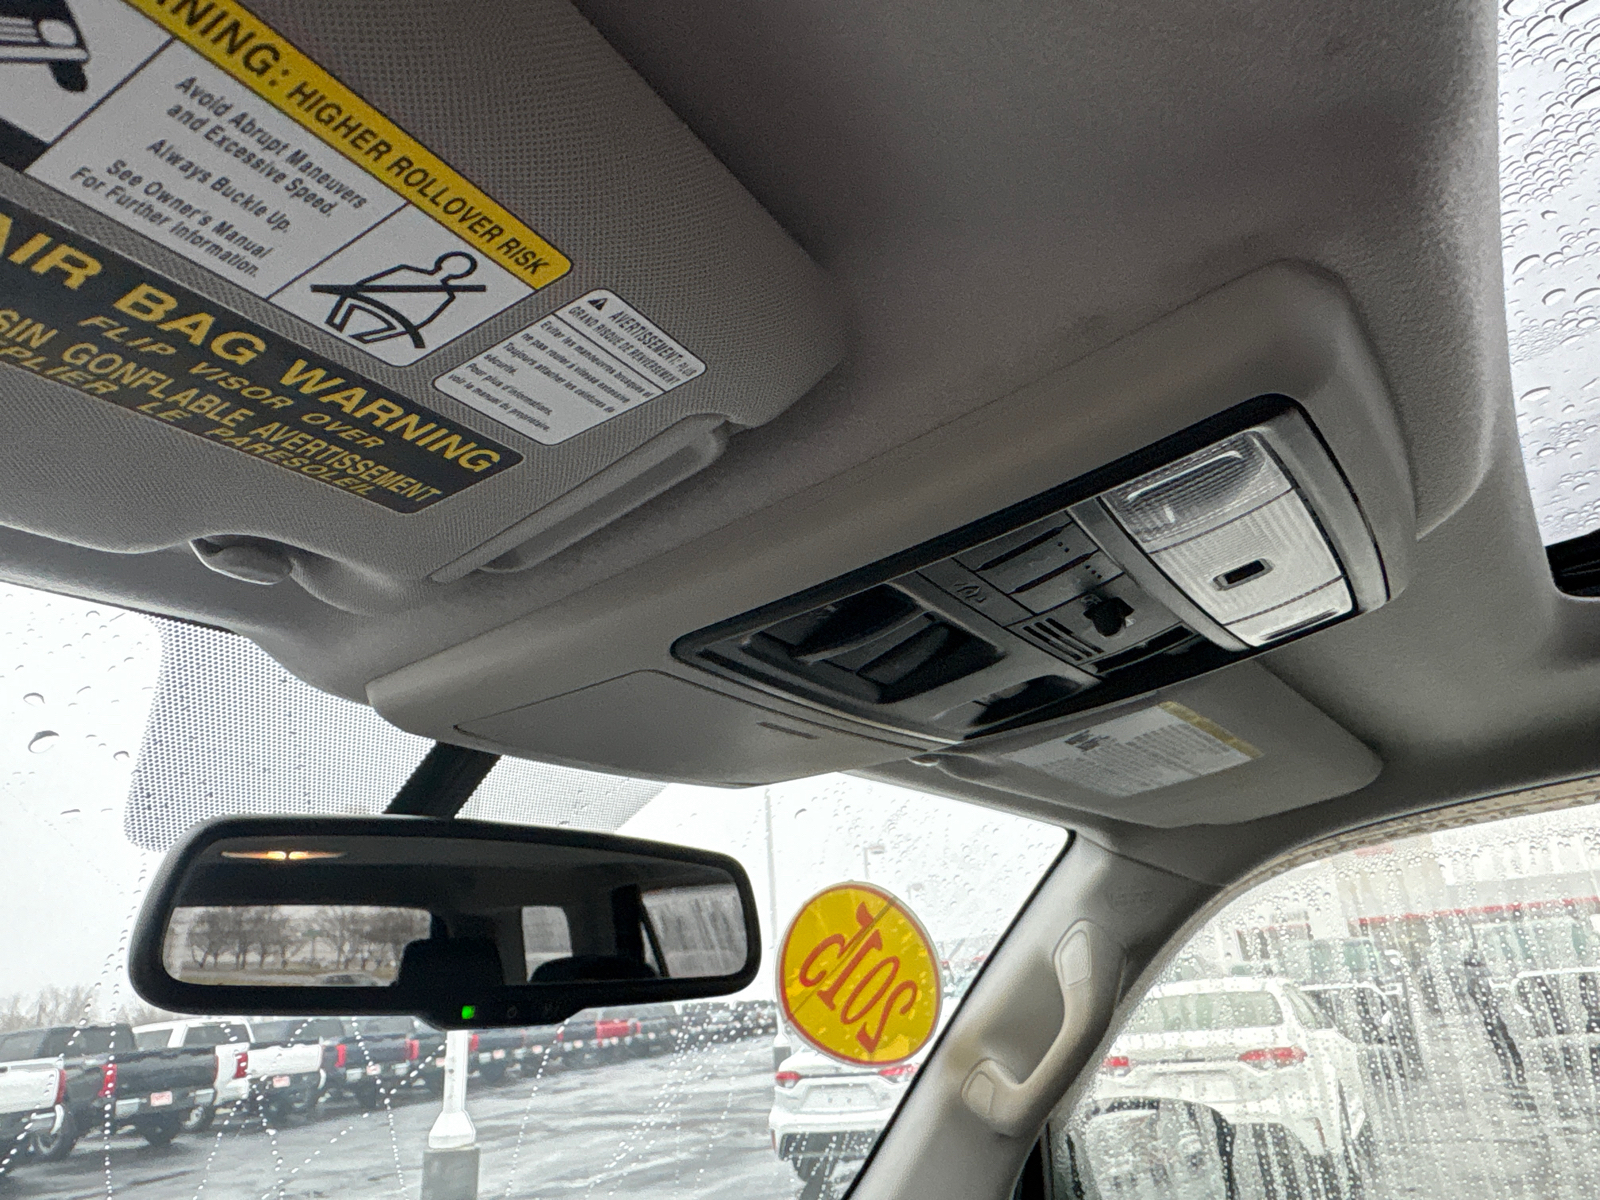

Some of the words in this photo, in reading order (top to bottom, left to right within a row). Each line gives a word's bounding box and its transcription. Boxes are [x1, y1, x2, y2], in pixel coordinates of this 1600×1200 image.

[146, 139, 212, 184] Always
[210, 176, 268, 217] Buckle
[266, 210, 291, 233] Up.
[157, 0, 290, 87] NING:
[285, 80, 393, 163] HIGHER
[385, 154, 504, 244] ROLLOVER
[497, 236, 550, 276] RISK
[166, 104, 210, 132] and
[203, 124, 287, 184] Excessive
[284, 177, 338, 217] Speed.
[175, 76, 234, 118] Avoid
[227, 112, 290, 156] Abrupt
[285, 148, 367, 209] Maneuvers
[70, 166, 107, 191] For
[104, 185, 172, 226] Further
[169, 221, 259, 278] Information.
[106, 159, 143, 187] See
[143, 181, 213, 227] Owner's
[211, 220, 274, 259] Manual
[78, 315, 176, 355] FLIP
[189, 361, 293, 408] VISOR
[301, 412, 384, 448] OVER
[114, 283, 266, 366] BAG
[279, 358, 500, 472] WARNING
[568, 306, 599, 328] GRAND
[595, 323, 625, 346] RISQUE
[617, 341, 635, 353] DE
[627, 348, 681, 385] RENVERSEMENT
[608, 310, 684, 363] AVERTISSEMENT:
[0, 345, 118, 393] PLIER
[137, 400, 191, 421] LE
[207, 426, 373, 495] PARESOLEIL
[61, 342, 254, 427] GONFLABLE
[249, 421, 441, 500] AVERTISSEMENT
